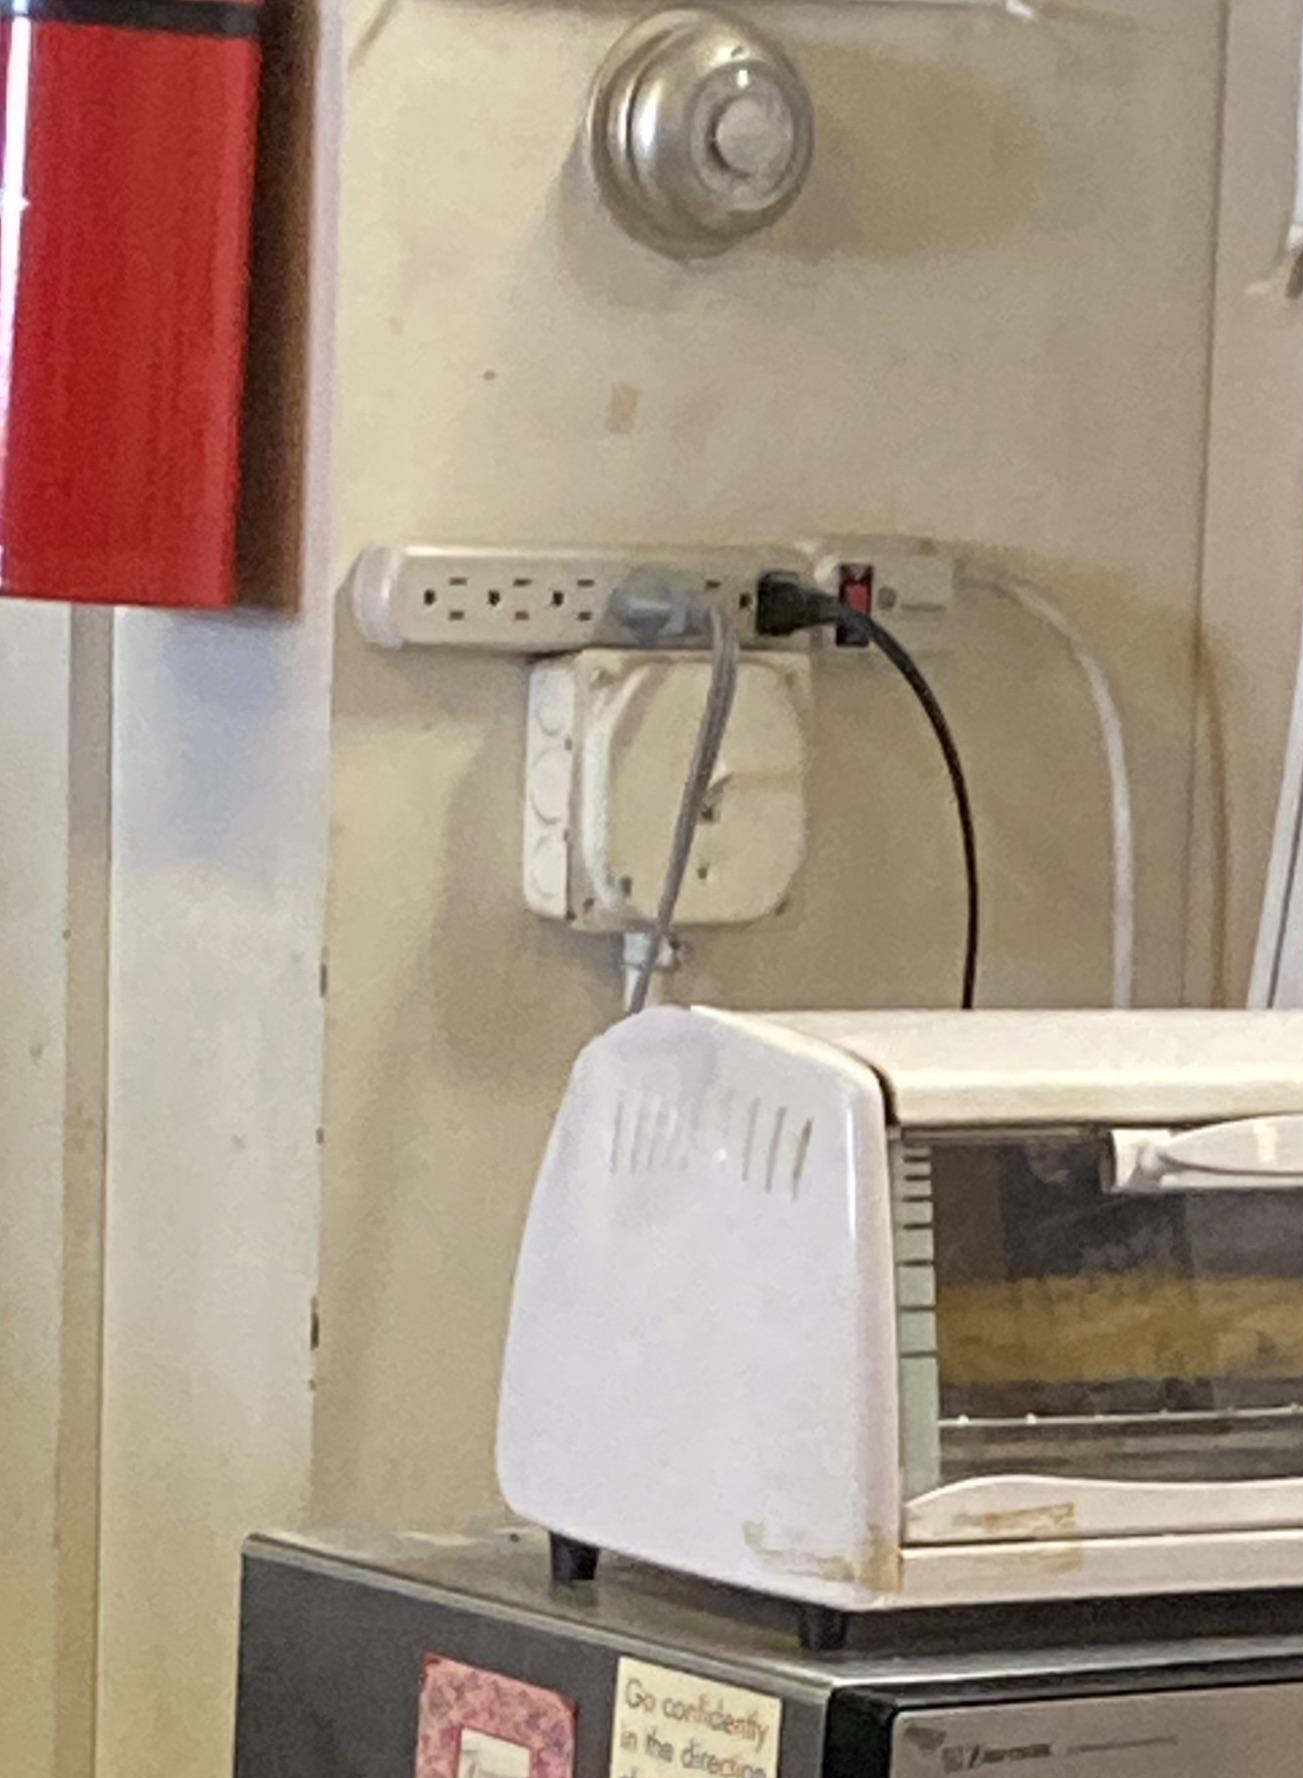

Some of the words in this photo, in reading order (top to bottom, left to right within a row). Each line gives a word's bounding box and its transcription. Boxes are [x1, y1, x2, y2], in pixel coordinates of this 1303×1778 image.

[625, 1678, 656, 1712] Go
[661, 1694, 769, 1754] confidently
[620, 1730, 638, 1751] in
[645, 1727, 674, 1763] the
